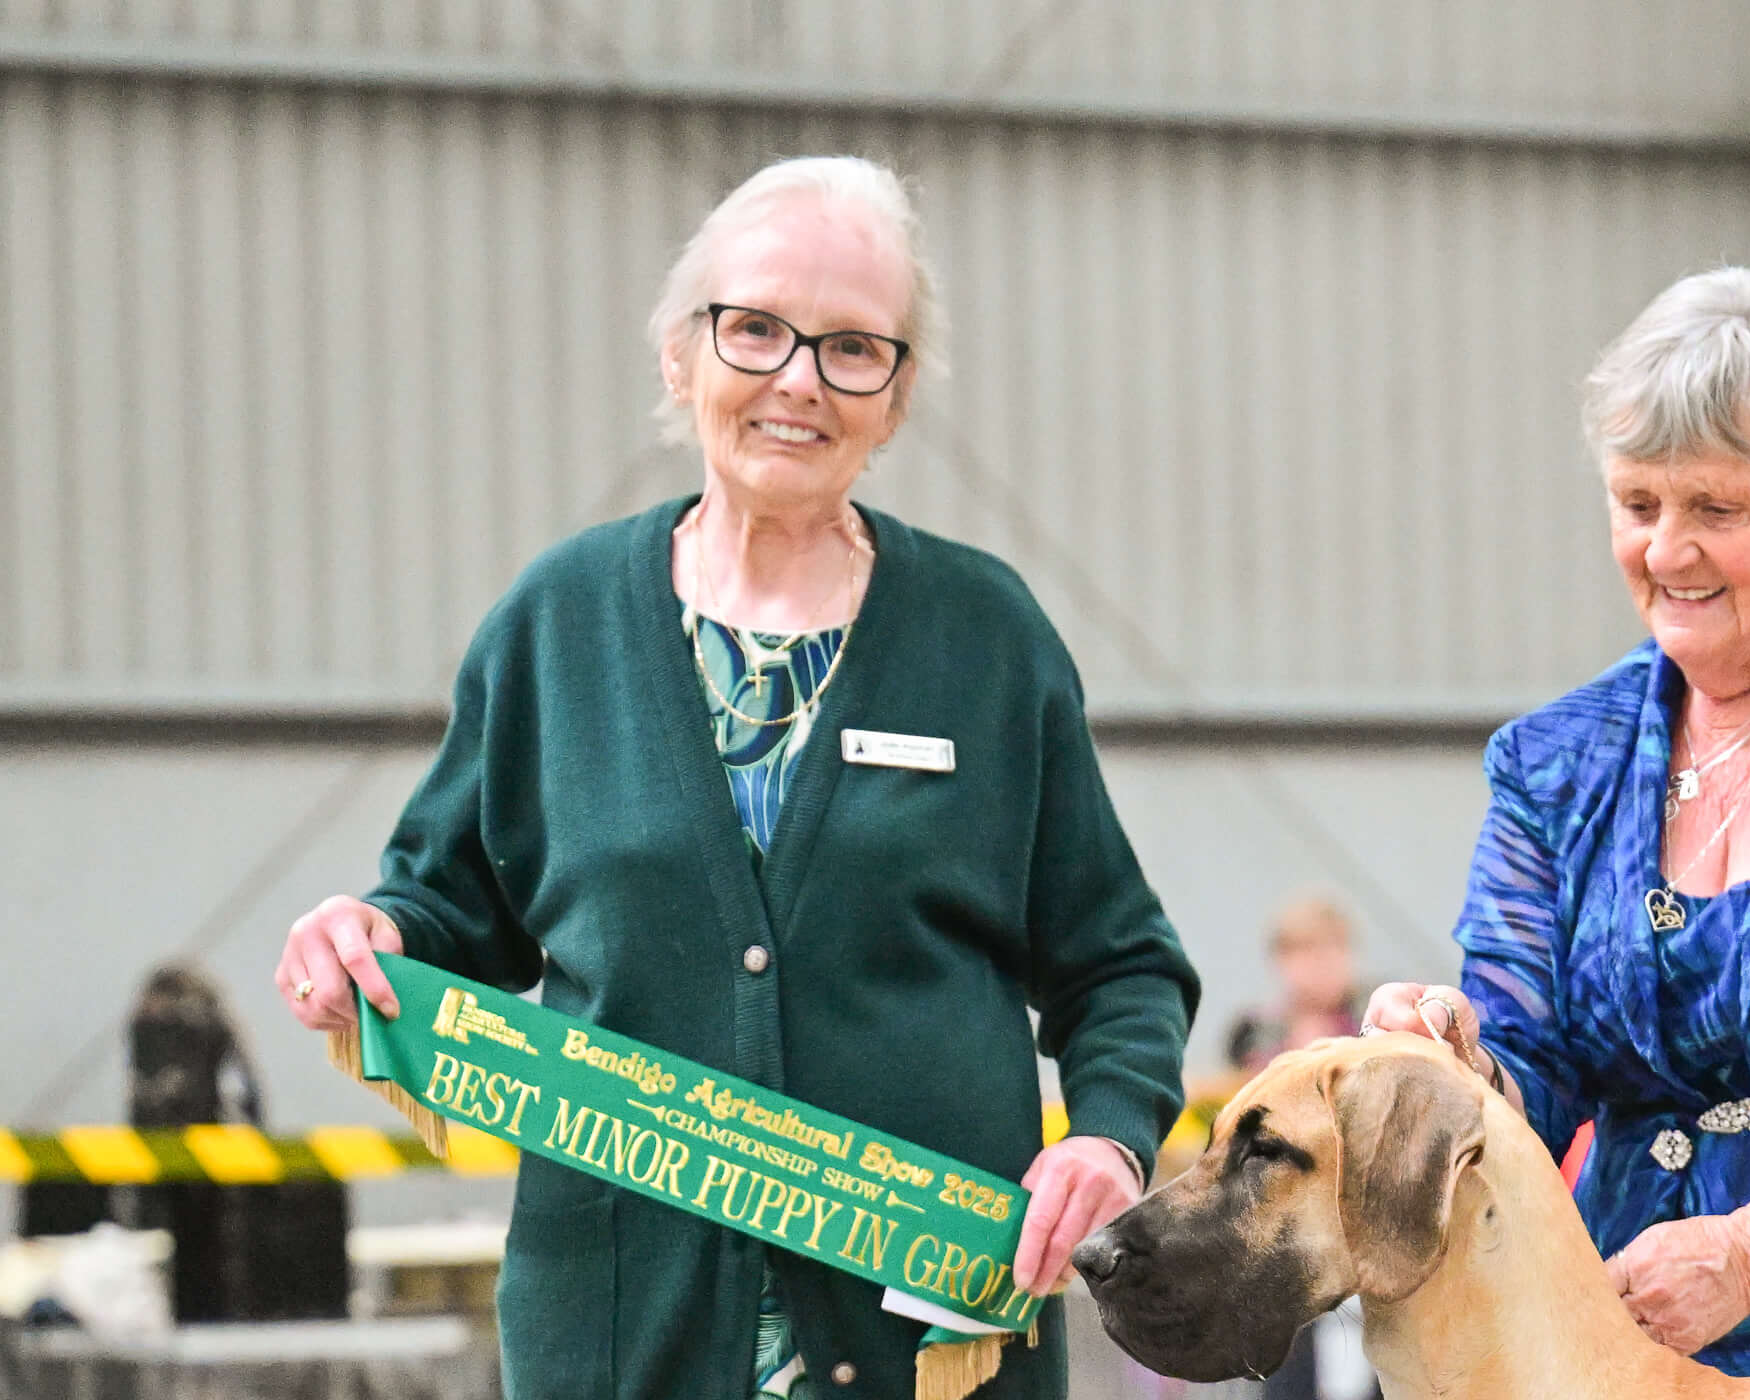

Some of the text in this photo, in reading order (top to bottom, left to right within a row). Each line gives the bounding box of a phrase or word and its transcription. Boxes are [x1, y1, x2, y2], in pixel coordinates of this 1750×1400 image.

[421, 1051, 541, 1137] BEST
[543, 1096, 690, 1198] MINOR
[690, 1154, 844, 1251] PUPPY
[837, 1206, 899, 1271] IN
[560, 1028, 677, 1095] Bendigo
[684, 1077, 854, 1160] Agricultural
[859, 1141, 935, 1188] Show
[938, 1173, 1013, 1222] 2025
[665, 1109, 885, 1202] CHAMPIONSHIP SHOW
